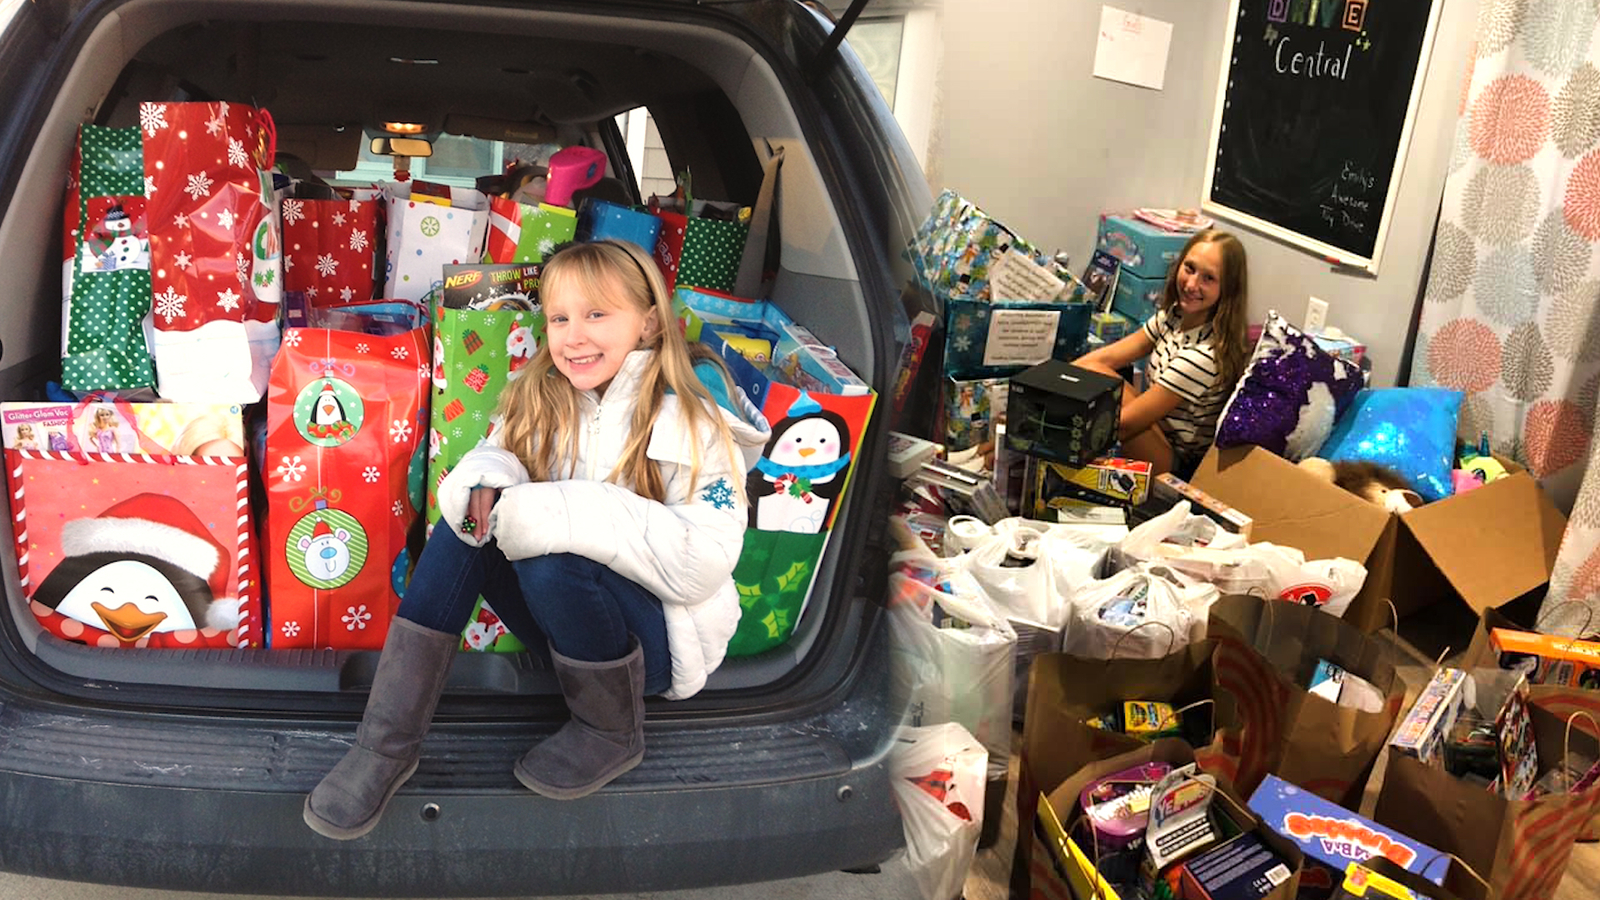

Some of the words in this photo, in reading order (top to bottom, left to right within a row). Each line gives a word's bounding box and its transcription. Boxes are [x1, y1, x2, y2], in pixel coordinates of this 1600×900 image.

[1275, 36, 1352, 80] Central
[444, 270, 482, 289] NERF
[490, 269, 520, 282] THROW
[522, 266, 538, 277] LIKE
[523, 278, 540, 290] PRO
[8, 411, 32, 421] Glitter
[33, 409, 54, 419] Glam
[55, 408, 69, 418] Vac
